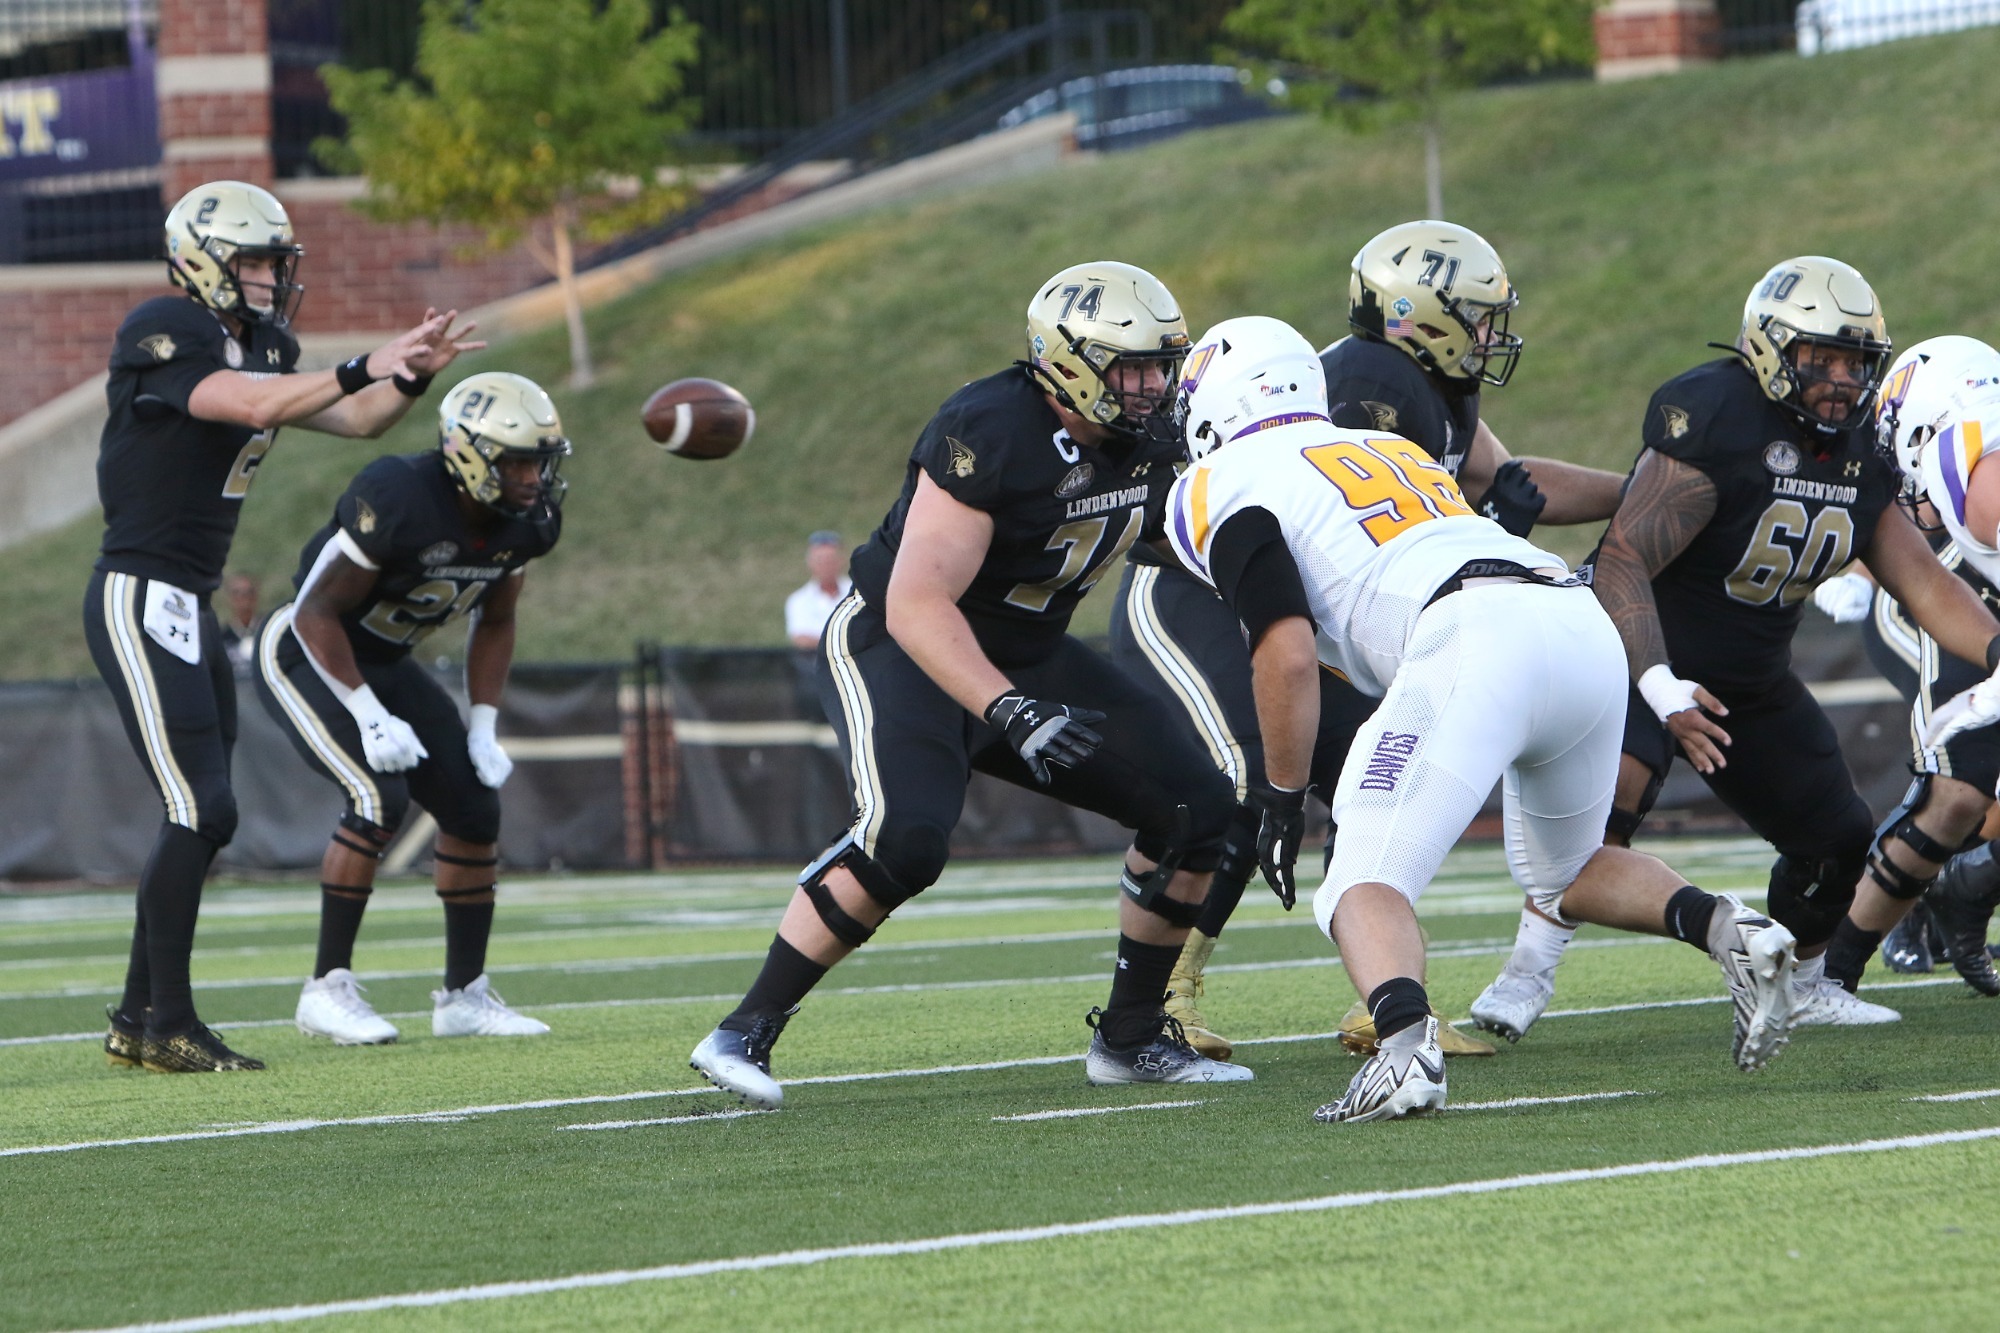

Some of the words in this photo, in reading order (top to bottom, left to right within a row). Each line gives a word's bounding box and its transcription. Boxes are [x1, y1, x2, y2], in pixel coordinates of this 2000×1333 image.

[195, 197, 220, 226] 2
[1418, 249, 1461, 295] 71
[1760, 270, 1804, 302] 60
[1058, 284, 1105, 322] 74
[459, 391, 498, 421] 21
[1053, 427, 1079, 464] C
[1066, 484, 1149, 519] LINDENWOOD
[1300, 438, 1478, 548] 96
[1773, 476, 1858, 504] LINDENWOOD
[1724, 498, 1854, 608] 60
[359, 579, 488, 645] 21
[1359, 731, 1420, 793] DAWGS
